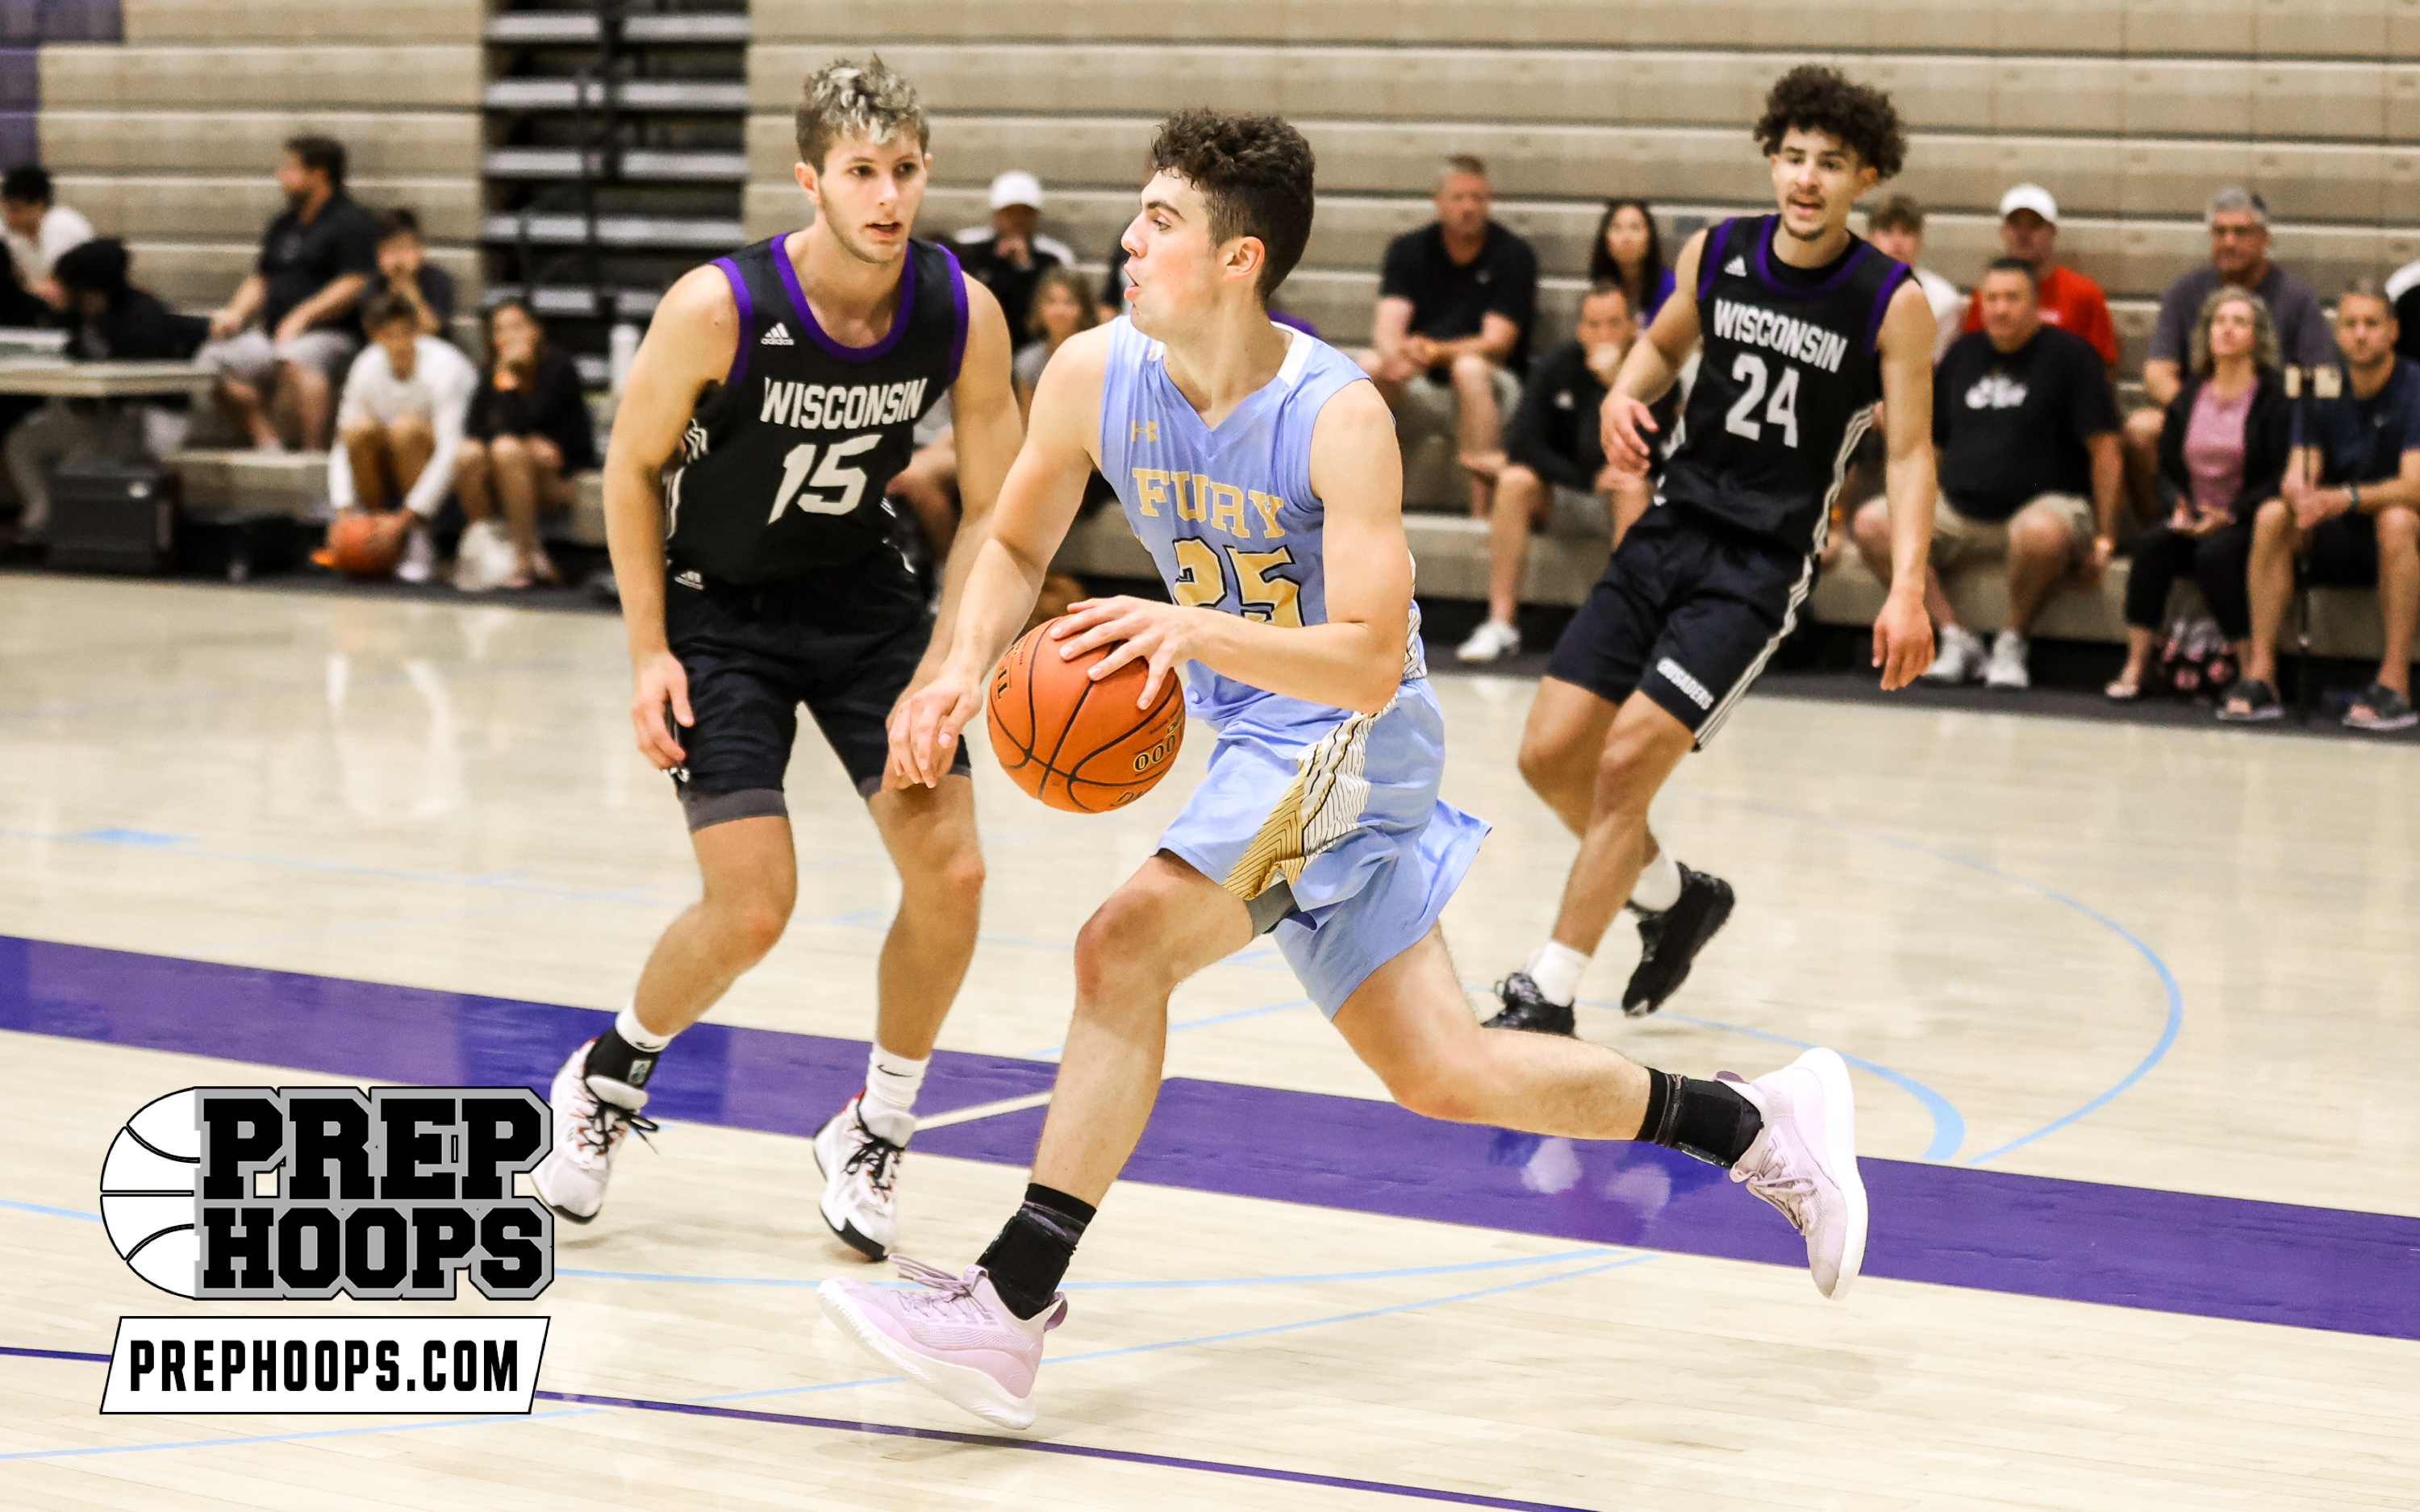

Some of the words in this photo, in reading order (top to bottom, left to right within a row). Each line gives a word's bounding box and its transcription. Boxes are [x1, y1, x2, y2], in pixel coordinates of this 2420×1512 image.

[1713, 298, 1848, 374] WISCONSIN
[759, 377, 928, 429] WISCONSIN
[1725, 352, 1800, 448] 24
[767, 434, 883, 525] 15
[1132, 468, 1286, 539] FURY
[1172, 536, 1305, 627] 25
